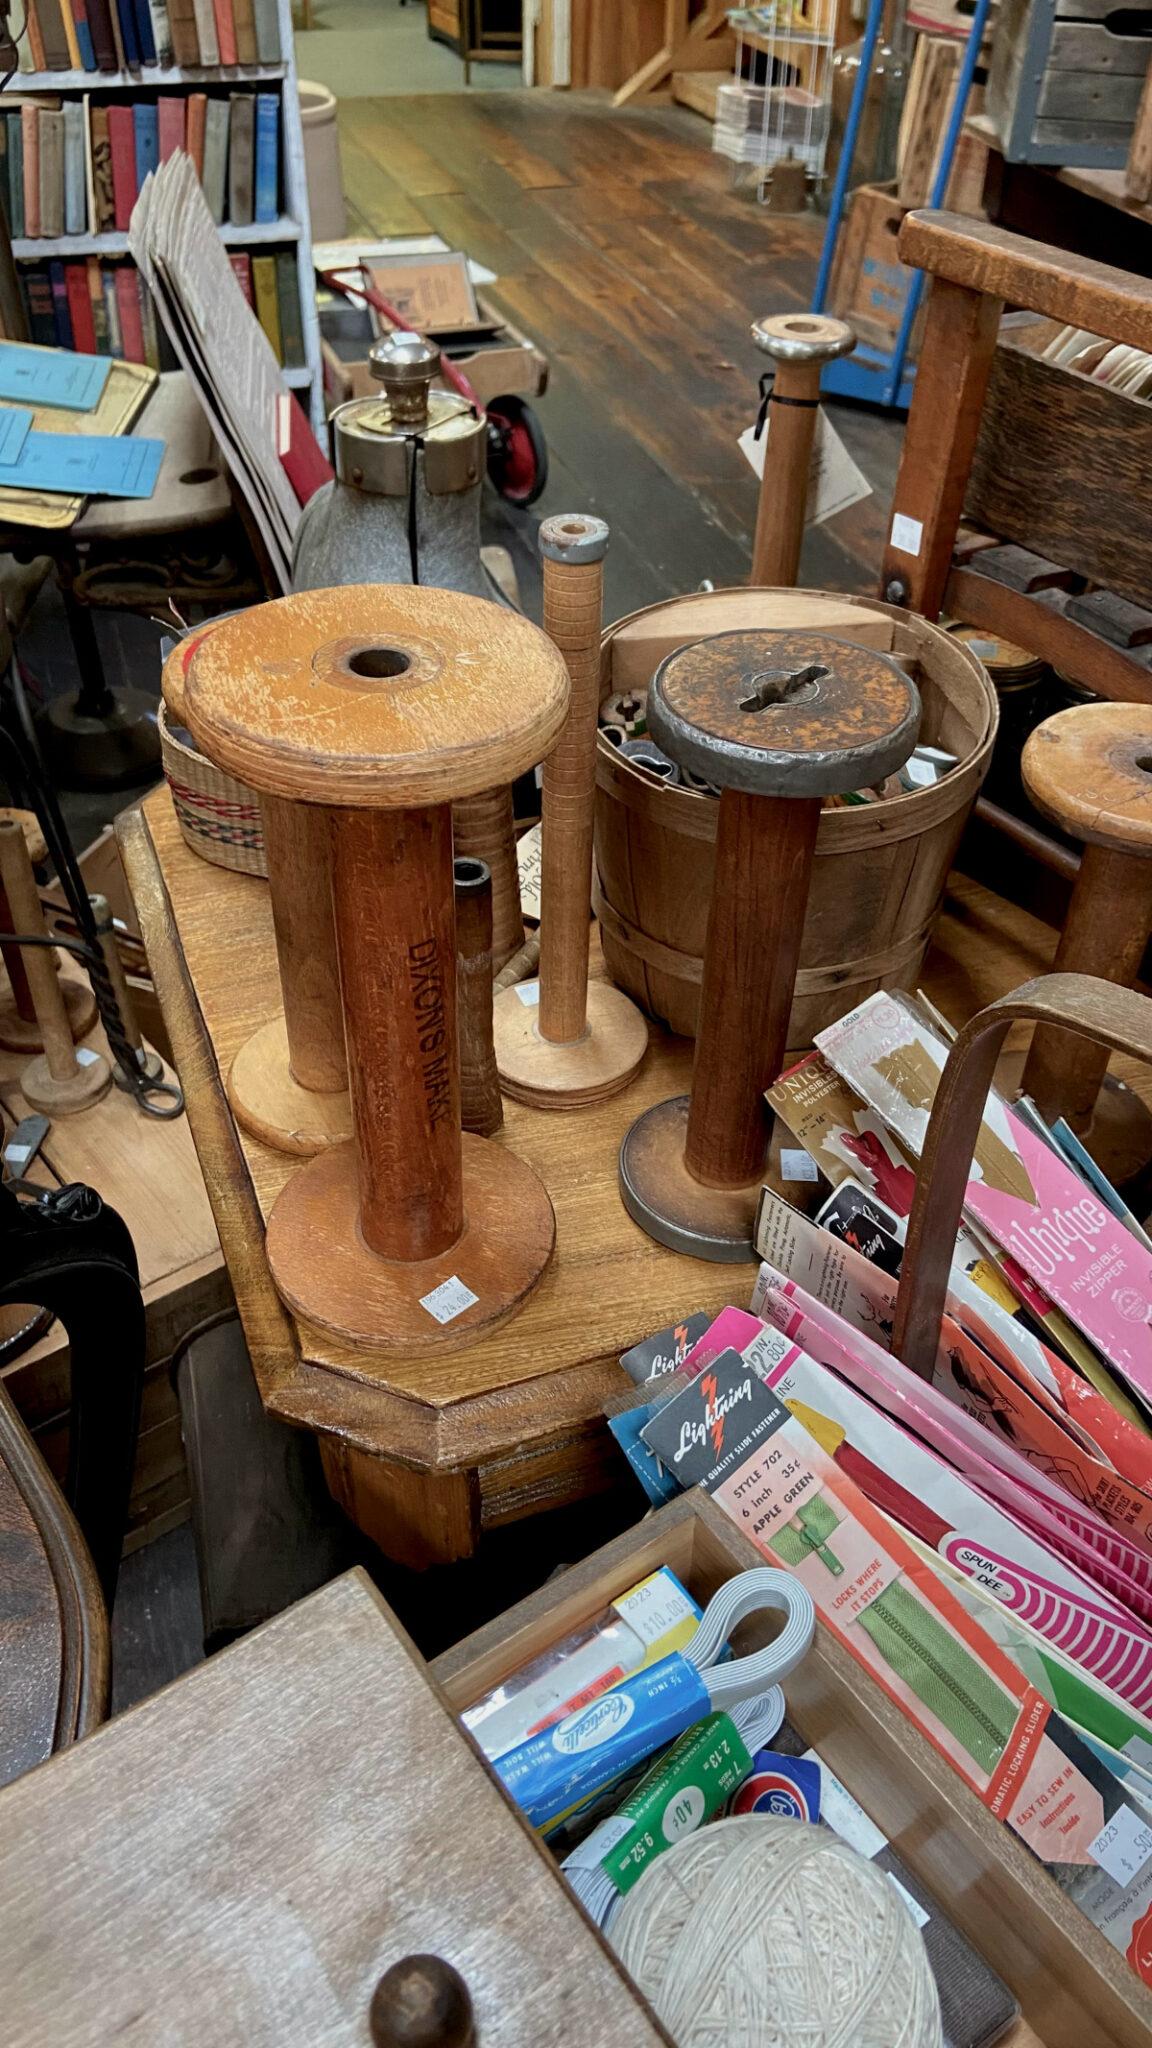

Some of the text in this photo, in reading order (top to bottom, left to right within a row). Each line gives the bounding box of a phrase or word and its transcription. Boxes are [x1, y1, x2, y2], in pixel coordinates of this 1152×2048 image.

[409, 937, 451, 1126] DIXON'S MAKE
[842, 1013, 860, 1028] GOLD
[803, 1080, 841, 1108] POLYESTER
[1009, 1199, 1107, 1275] Unique
[1070, 1243, 1123, 1294] INVISIBLE
[1086, 1259, 1128, 1299] ZIPPER
[756, 1337, 771, 1353] IN.
[776, 1376, 796, 1399] INE
[673, 1379, 752, 1463] Lightning
[708, 1454, 735, 1480] QUALITY
[734, 1435, 753, 1455] SLIDE
[751, 1408, 781, 1439] FASTENER
[733, 1450, 783, 1499] STYLE 702
[742, 1458, 801, 1518] 6 inch 35¢
[752, 1471, 814, 1535] APPLE GREEN
[961, 1550, 998, 1573] SPUN
[625, 1588, 651, 1610] 2023
[832, 1558, 883, 1610] LOCKS WHERE
[851, 1578, 884, 1612] IT STOPS
[977, 1573, 1003, 1592] DEE
[648, 1683, 670, 1697] INCH
[558, 1694, 629, 1753] Corticelli
[525, 1739, 546, 1756] WILL
[669, 1726, 705, 1762] BELDING
[990, 1700, 1045, 1814] OMATIC LOCKING SLIDER
[734, 1761, 742, 1776] 7
[672, 1799, 693, 1829] 40¢
[1016, 1767, 1075, 1826] EASY TO SEW IN
[1039, 1792, 1076, 1829] Instructions
[1058, 1814, 1081, 1836] Inside
[1094, 1825, 1119, 1853] 2023
[1104, 1898, 1134, 1928] français
